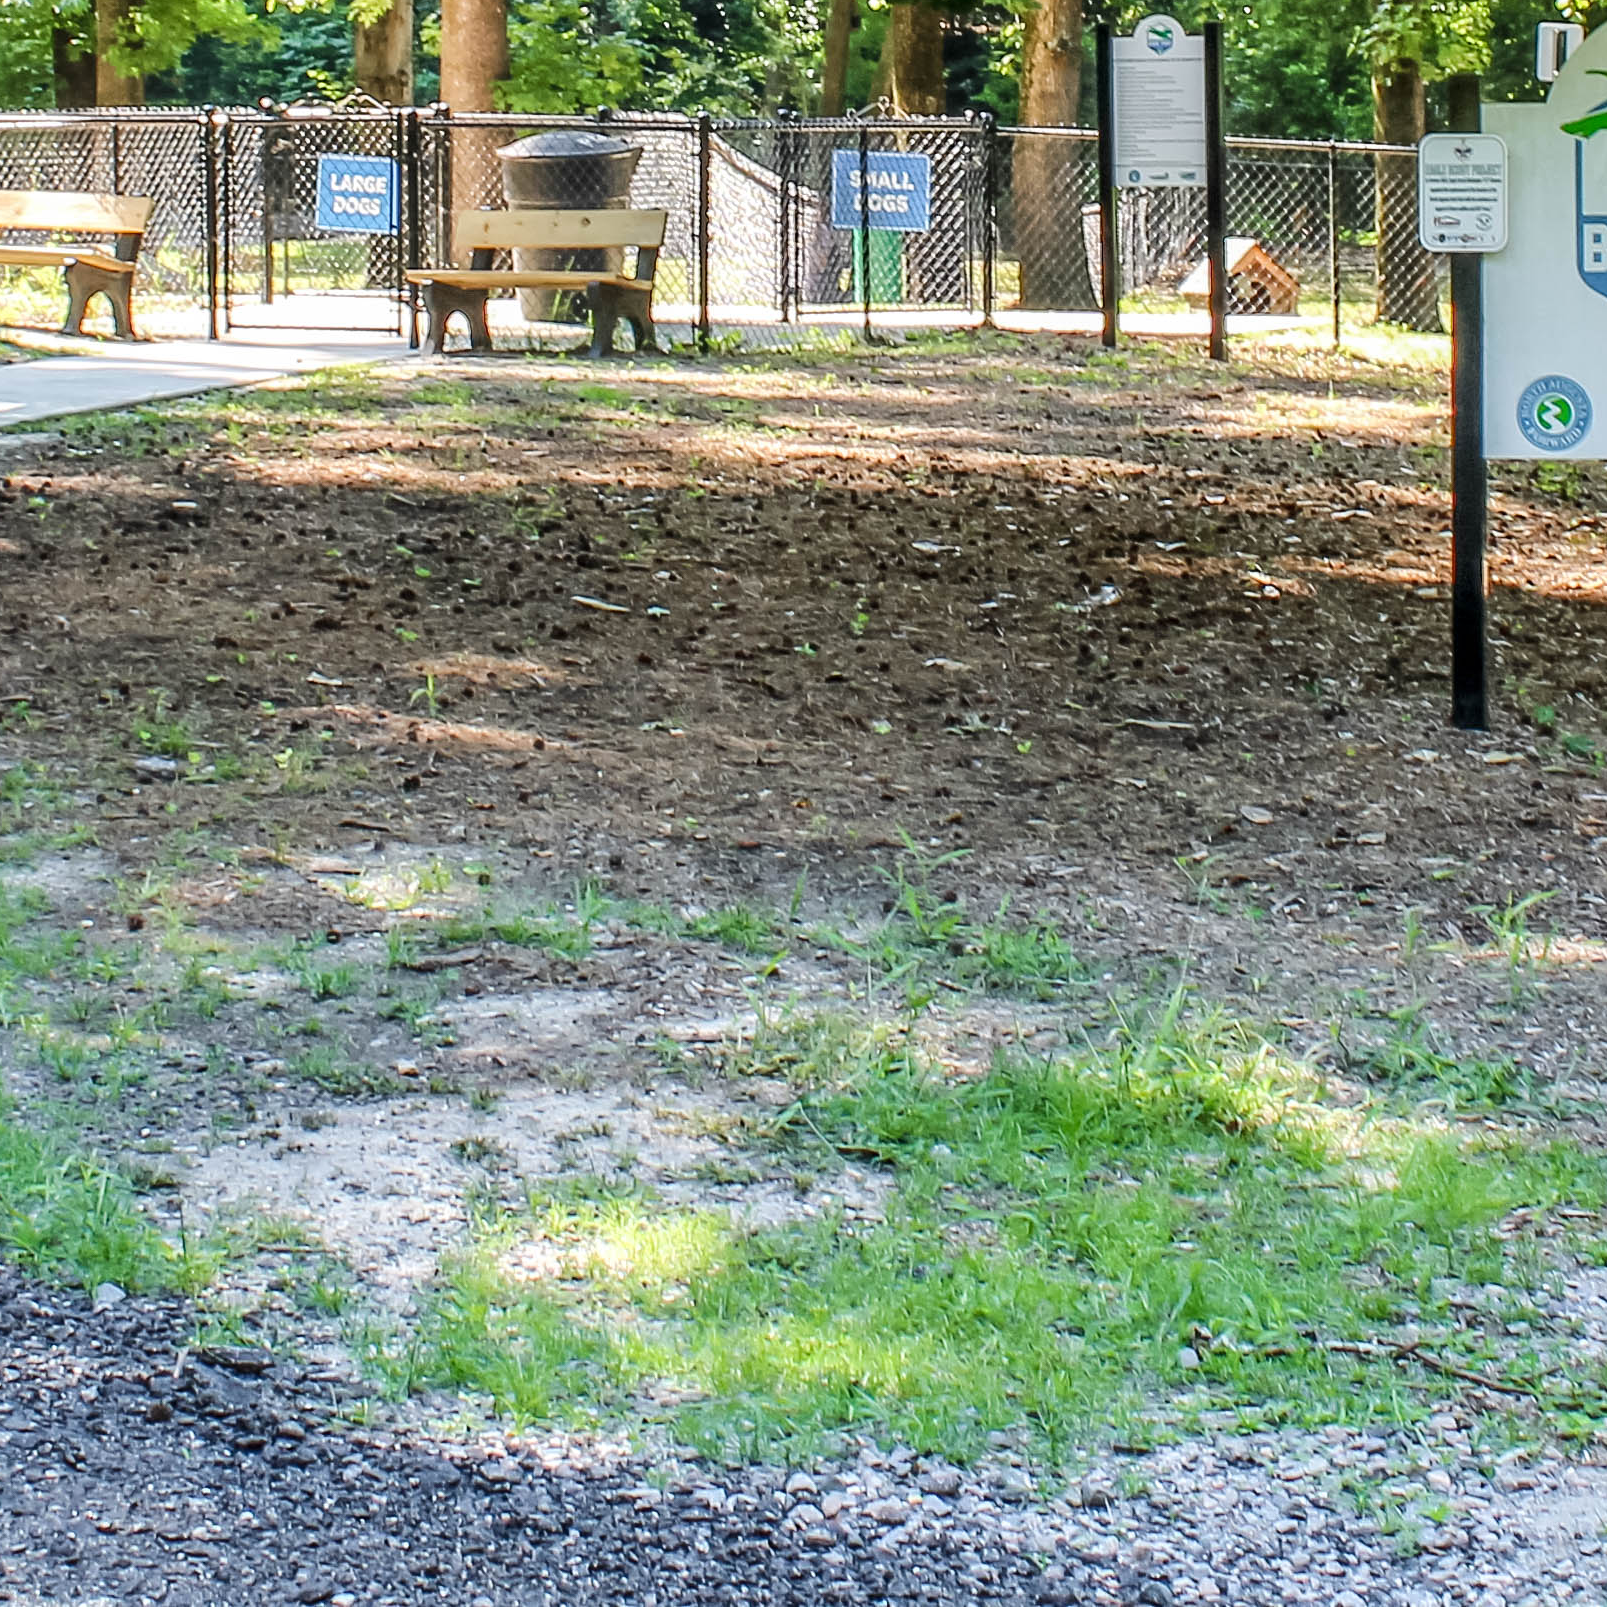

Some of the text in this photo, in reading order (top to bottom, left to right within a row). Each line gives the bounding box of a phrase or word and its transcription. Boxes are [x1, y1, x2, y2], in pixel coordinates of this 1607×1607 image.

[330, 173, 388, 194] LARGE
[849, 170, 915, 191] SMALL
[332, 195, 382, 215] DOGS
